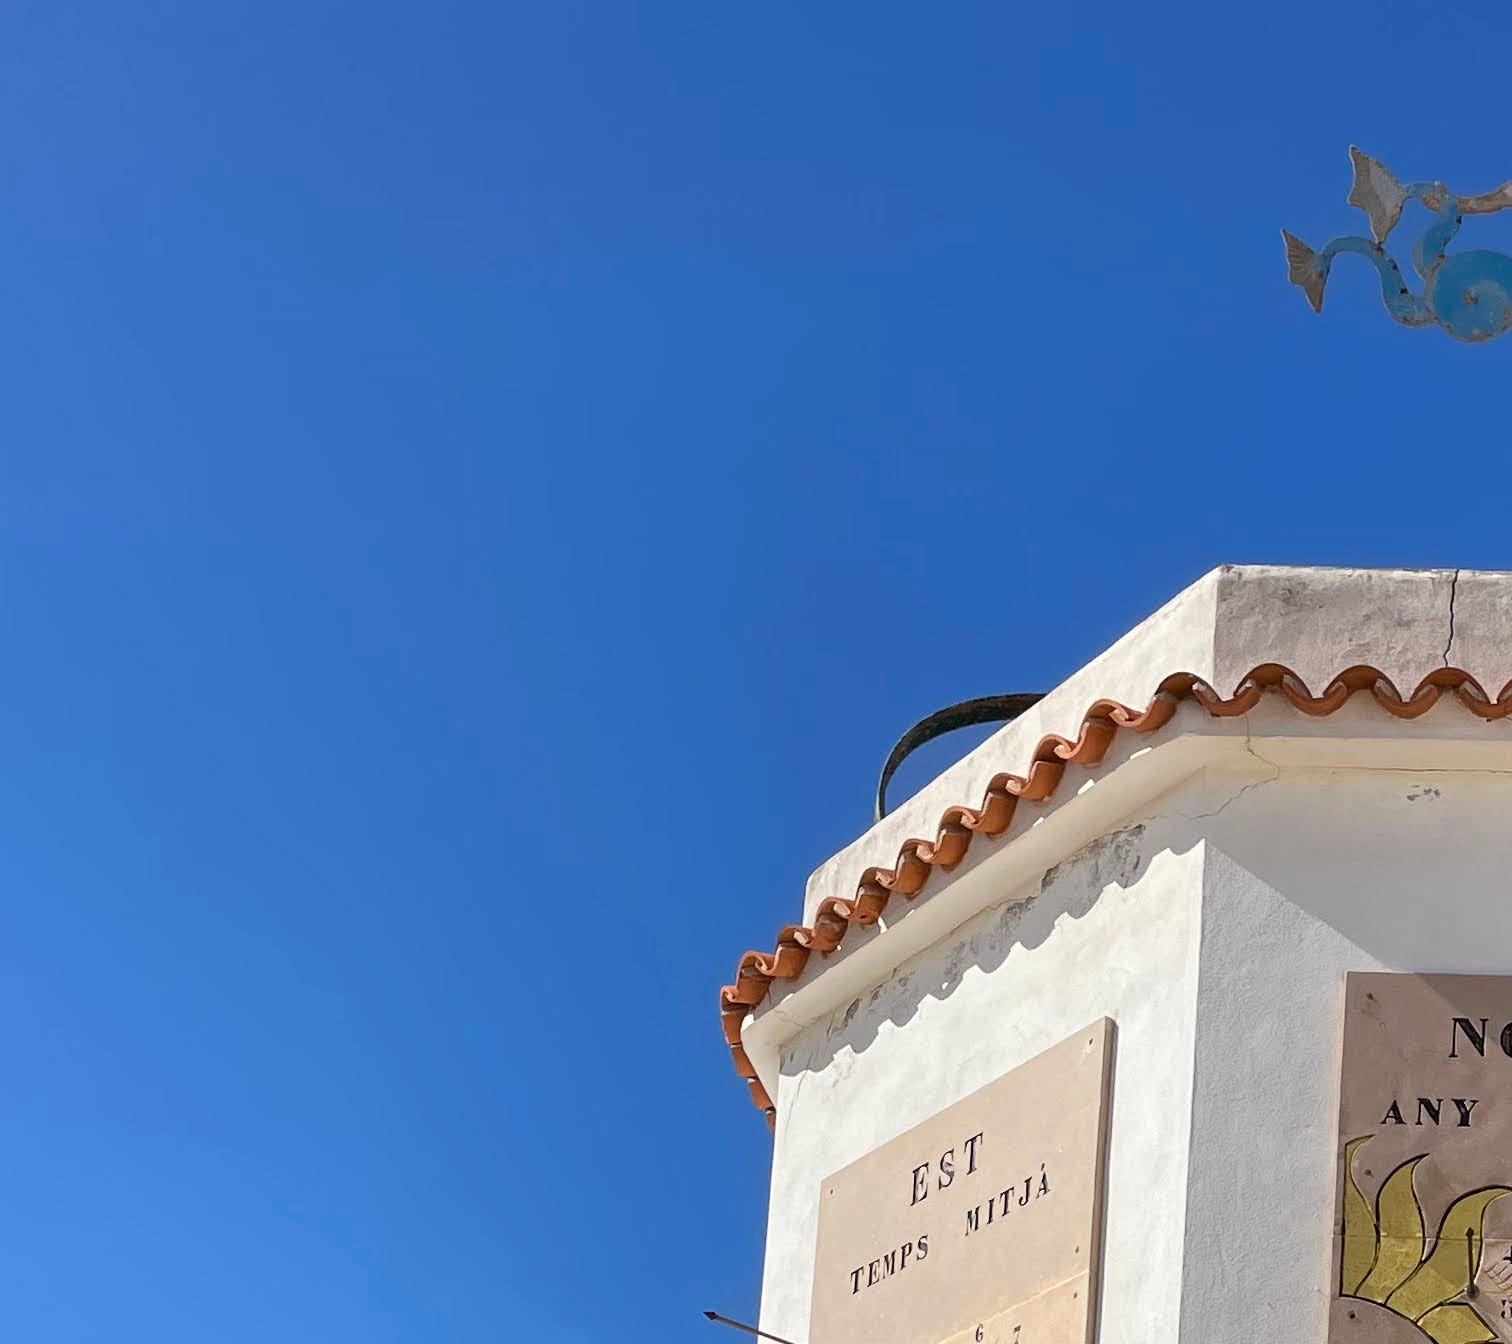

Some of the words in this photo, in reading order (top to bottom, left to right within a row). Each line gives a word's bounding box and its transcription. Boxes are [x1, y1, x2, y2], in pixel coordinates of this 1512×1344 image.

[1380, 1097, 1479, 1128] ANY
[910, 1132, 984, 1206] EST
[850, 1234, 929, 1295] TEMPS
[976, 1324, 984, 1342] 6
[1013, 1325, 1021, 1344] 7
